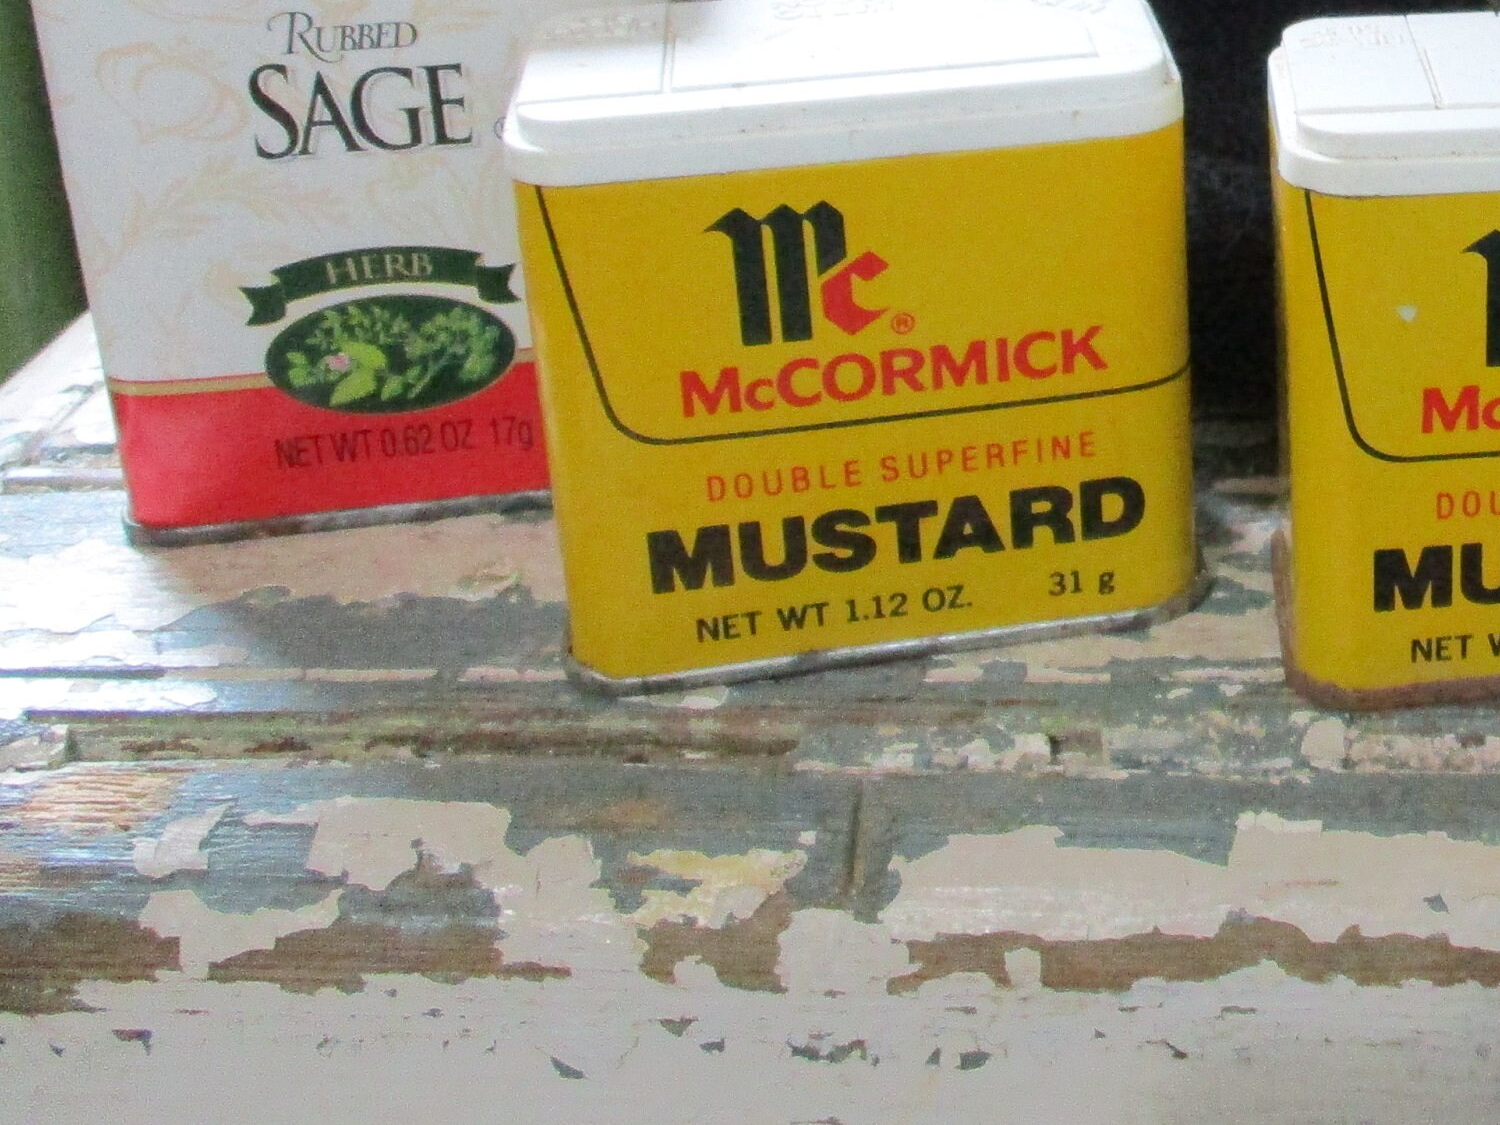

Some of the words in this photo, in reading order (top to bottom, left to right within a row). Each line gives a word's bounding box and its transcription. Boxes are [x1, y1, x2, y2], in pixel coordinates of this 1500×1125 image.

[267, 11, 418, 63] RUBBED
[249, 63, 473, 160] SAGE
[326, 253, 433, 285] HERB
[680, 325, 1108, 418] McCORMICK
[274, 434, 324, 469] NET
[329, 429, 373, 463] WT
[379, 424, 435, 458] 0.62
[439, 419, 474, 452] OZ
[705, 459, 861, 502] DOUBLE
[881, 431, 1098, 483] SUPERFINE
[646, 475, 1146, 595] MUSTARD
[1048, 570, 1082, 596] 31
[1098, 569, 1116, 597] g
[695, 613, 759, 643] NET
[776, 601, 829, 630] WT
[846, 592, 909, 624] 1.12
[922, 583, 974, 613] OZ.
[1410, 634, 1473, 663] NET
